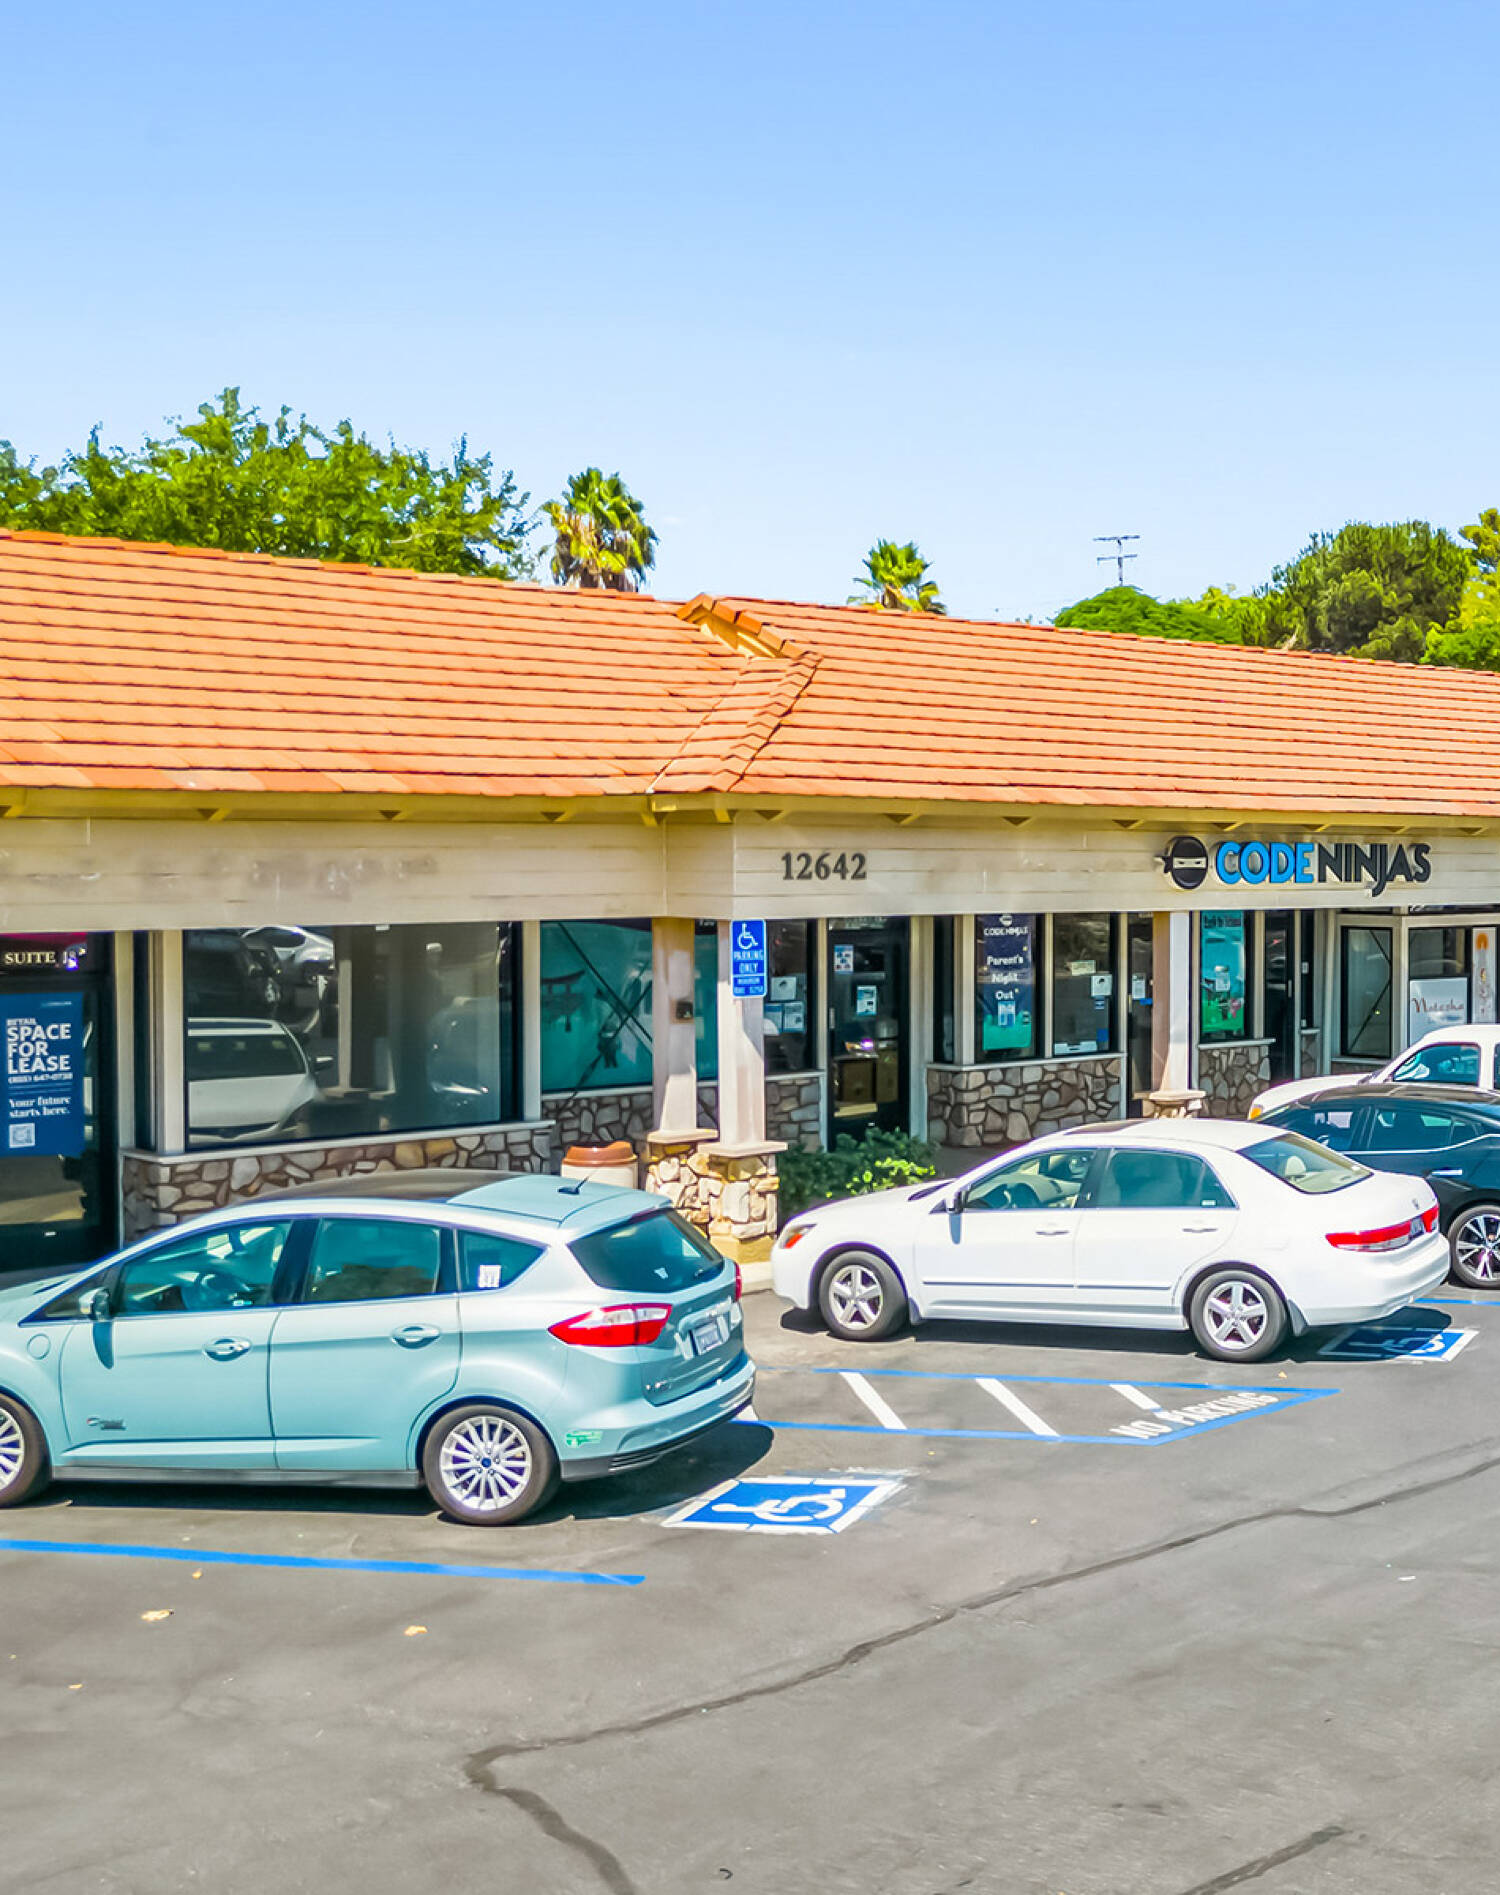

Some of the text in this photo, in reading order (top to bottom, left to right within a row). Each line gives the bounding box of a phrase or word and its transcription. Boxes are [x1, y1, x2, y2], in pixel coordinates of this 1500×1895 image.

[781, 852, 867, 881] 12642
[1215, 841, 1432, 898] CODE NINJAS
[4, 951, 56, 966] SUITE
[987, 955, 1024, 966] Parent's
[739, 963, 758, 974] ONLY
[992, 973, 1018, 984] Night
[995, 991, 1014, 1001] Out
[7, 1023, 72, 1041] SPACE
[8, 1041, 48, 1058] FOR
[8, 1055, 71, 1074] LEASE
[9, 1096, 71, 1109] Your future
[9, 1106, 70, 1118] starts here.
[1109, 1420, 1173, 1439] NO
